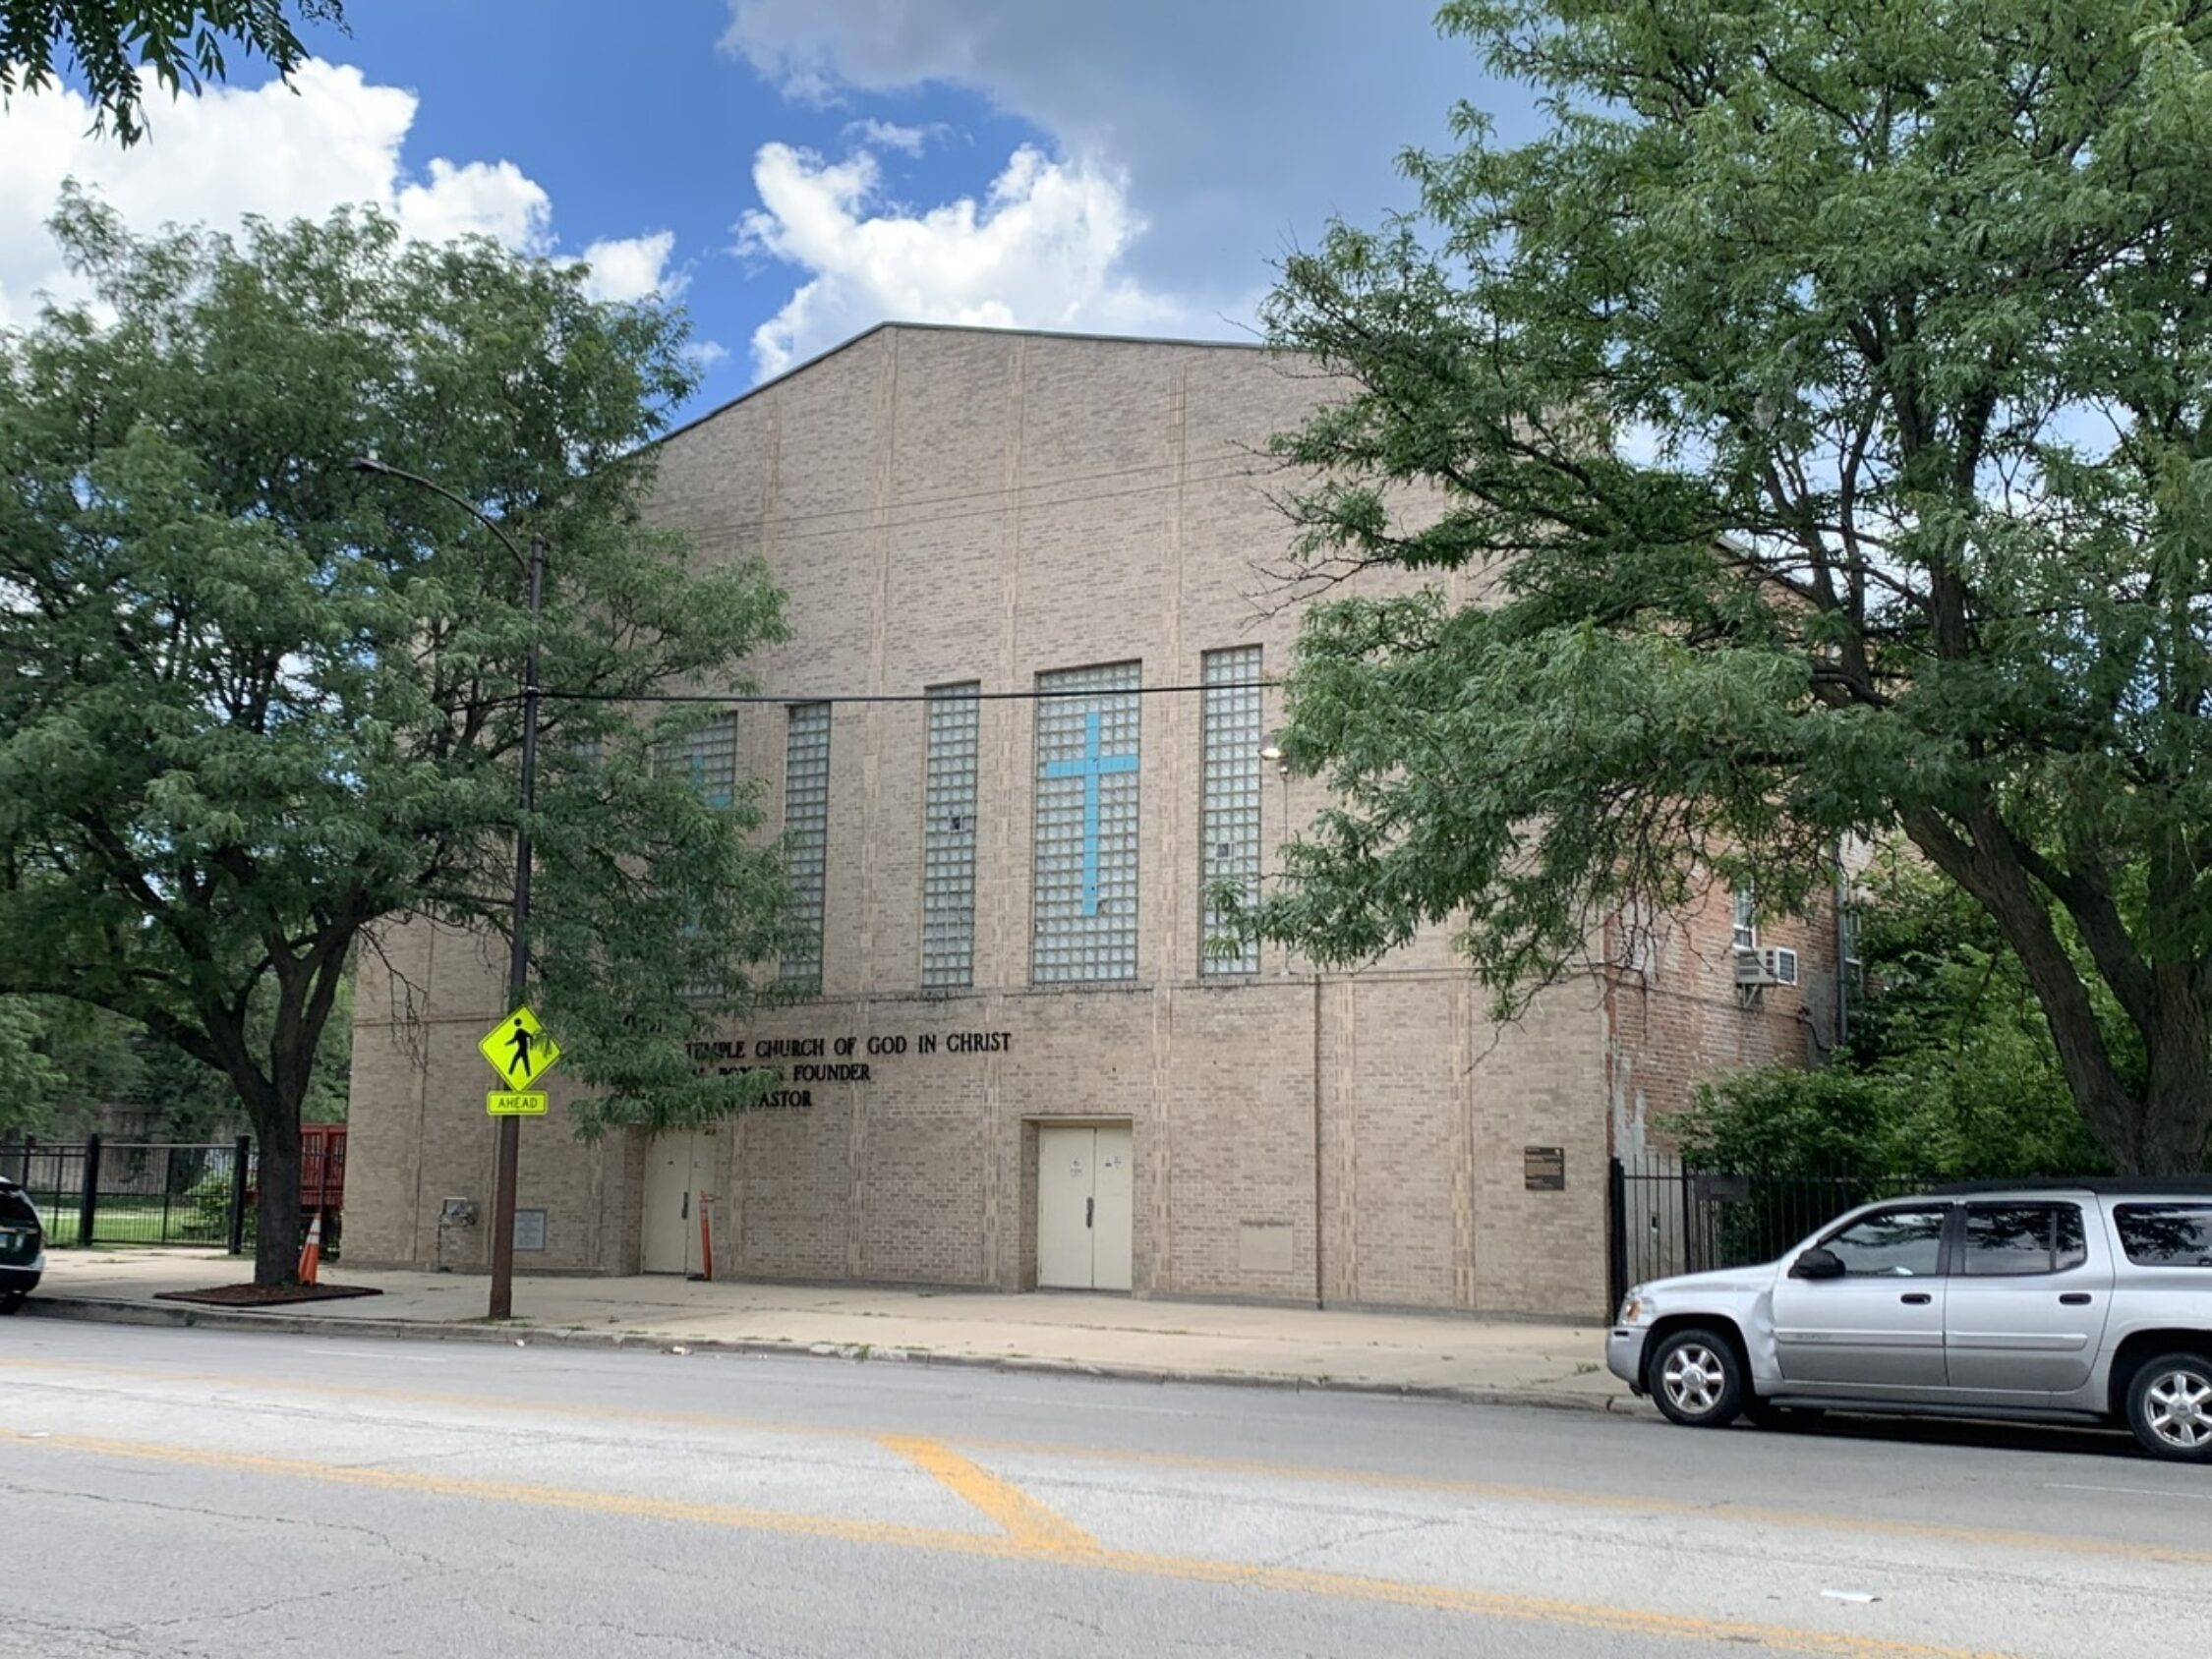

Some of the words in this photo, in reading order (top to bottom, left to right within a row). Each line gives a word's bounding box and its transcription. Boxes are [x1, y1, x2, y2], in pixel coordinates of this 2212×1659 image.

[755, 1037, 824, 1058] CHURCH
[834, 1036, 857, 1056] OF
[867, 1034, 907, 1055] GOD
[917, 1034, 937, 1054] IN
[947, 1031, 1012, 1053] CHRIST
[792, 1063, 871, 1082] FOUNDER
[497, 1096, 539, 1110] AHEAD
[751, 1089, 813, 1109] ASTOR
